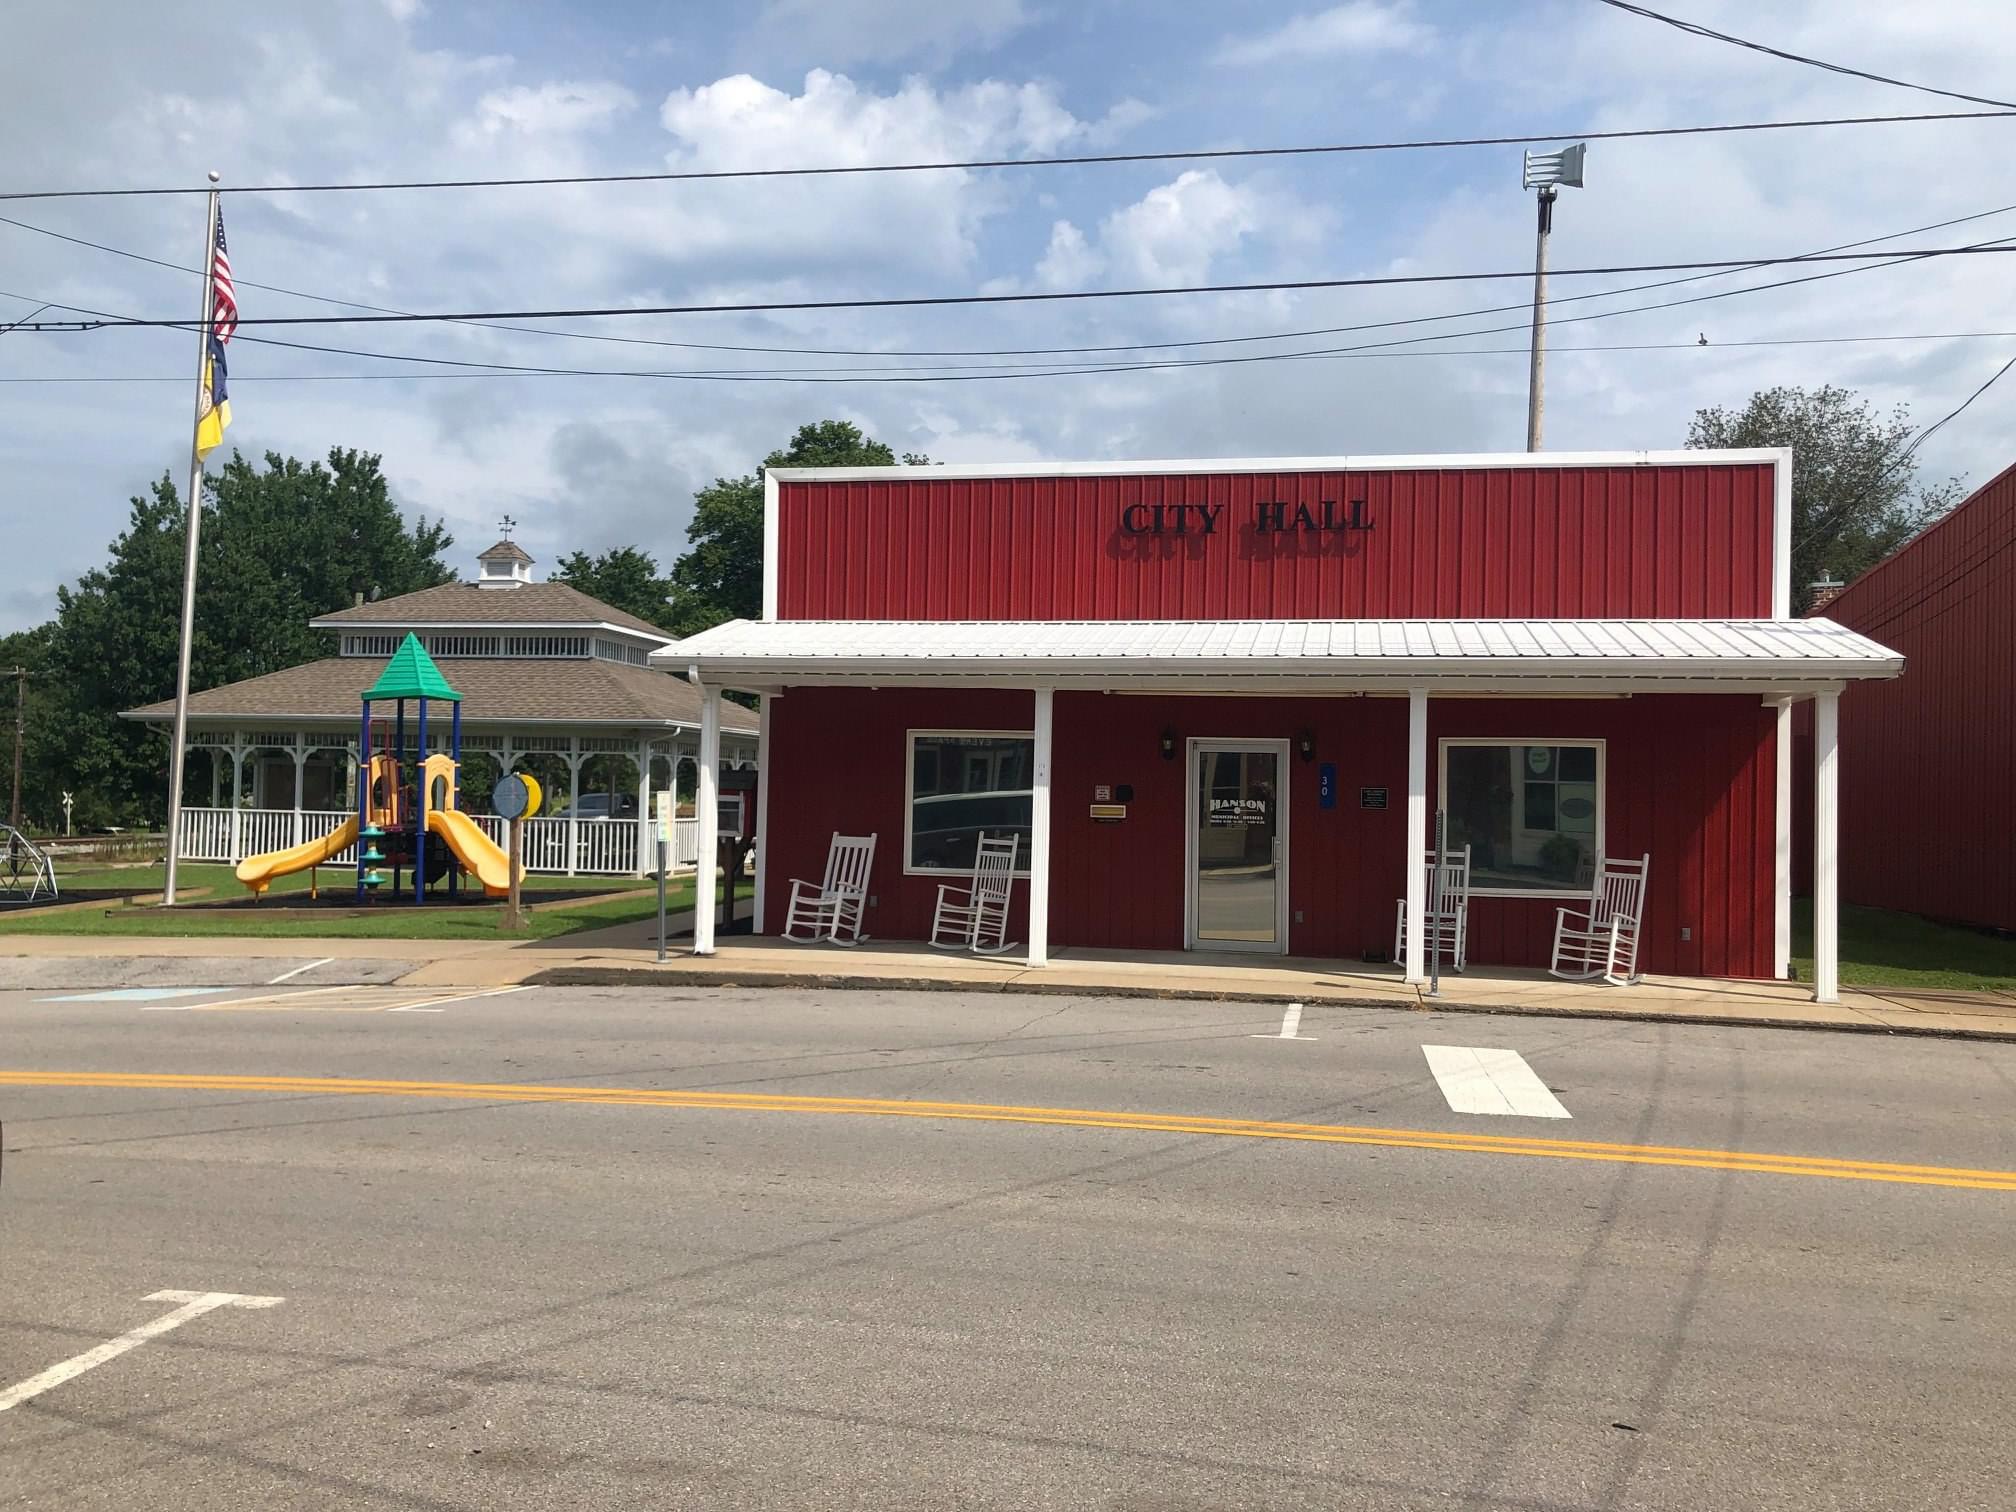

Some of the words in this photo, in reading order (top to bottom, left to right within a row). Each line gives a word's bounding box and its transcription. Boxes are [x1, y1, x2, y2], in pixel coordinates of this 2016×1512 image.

[1122, 503, 1225, 535] CITY
[1255, 500, 1375, 532] HALL
[1209, 799, 1266, 813] HANSON
